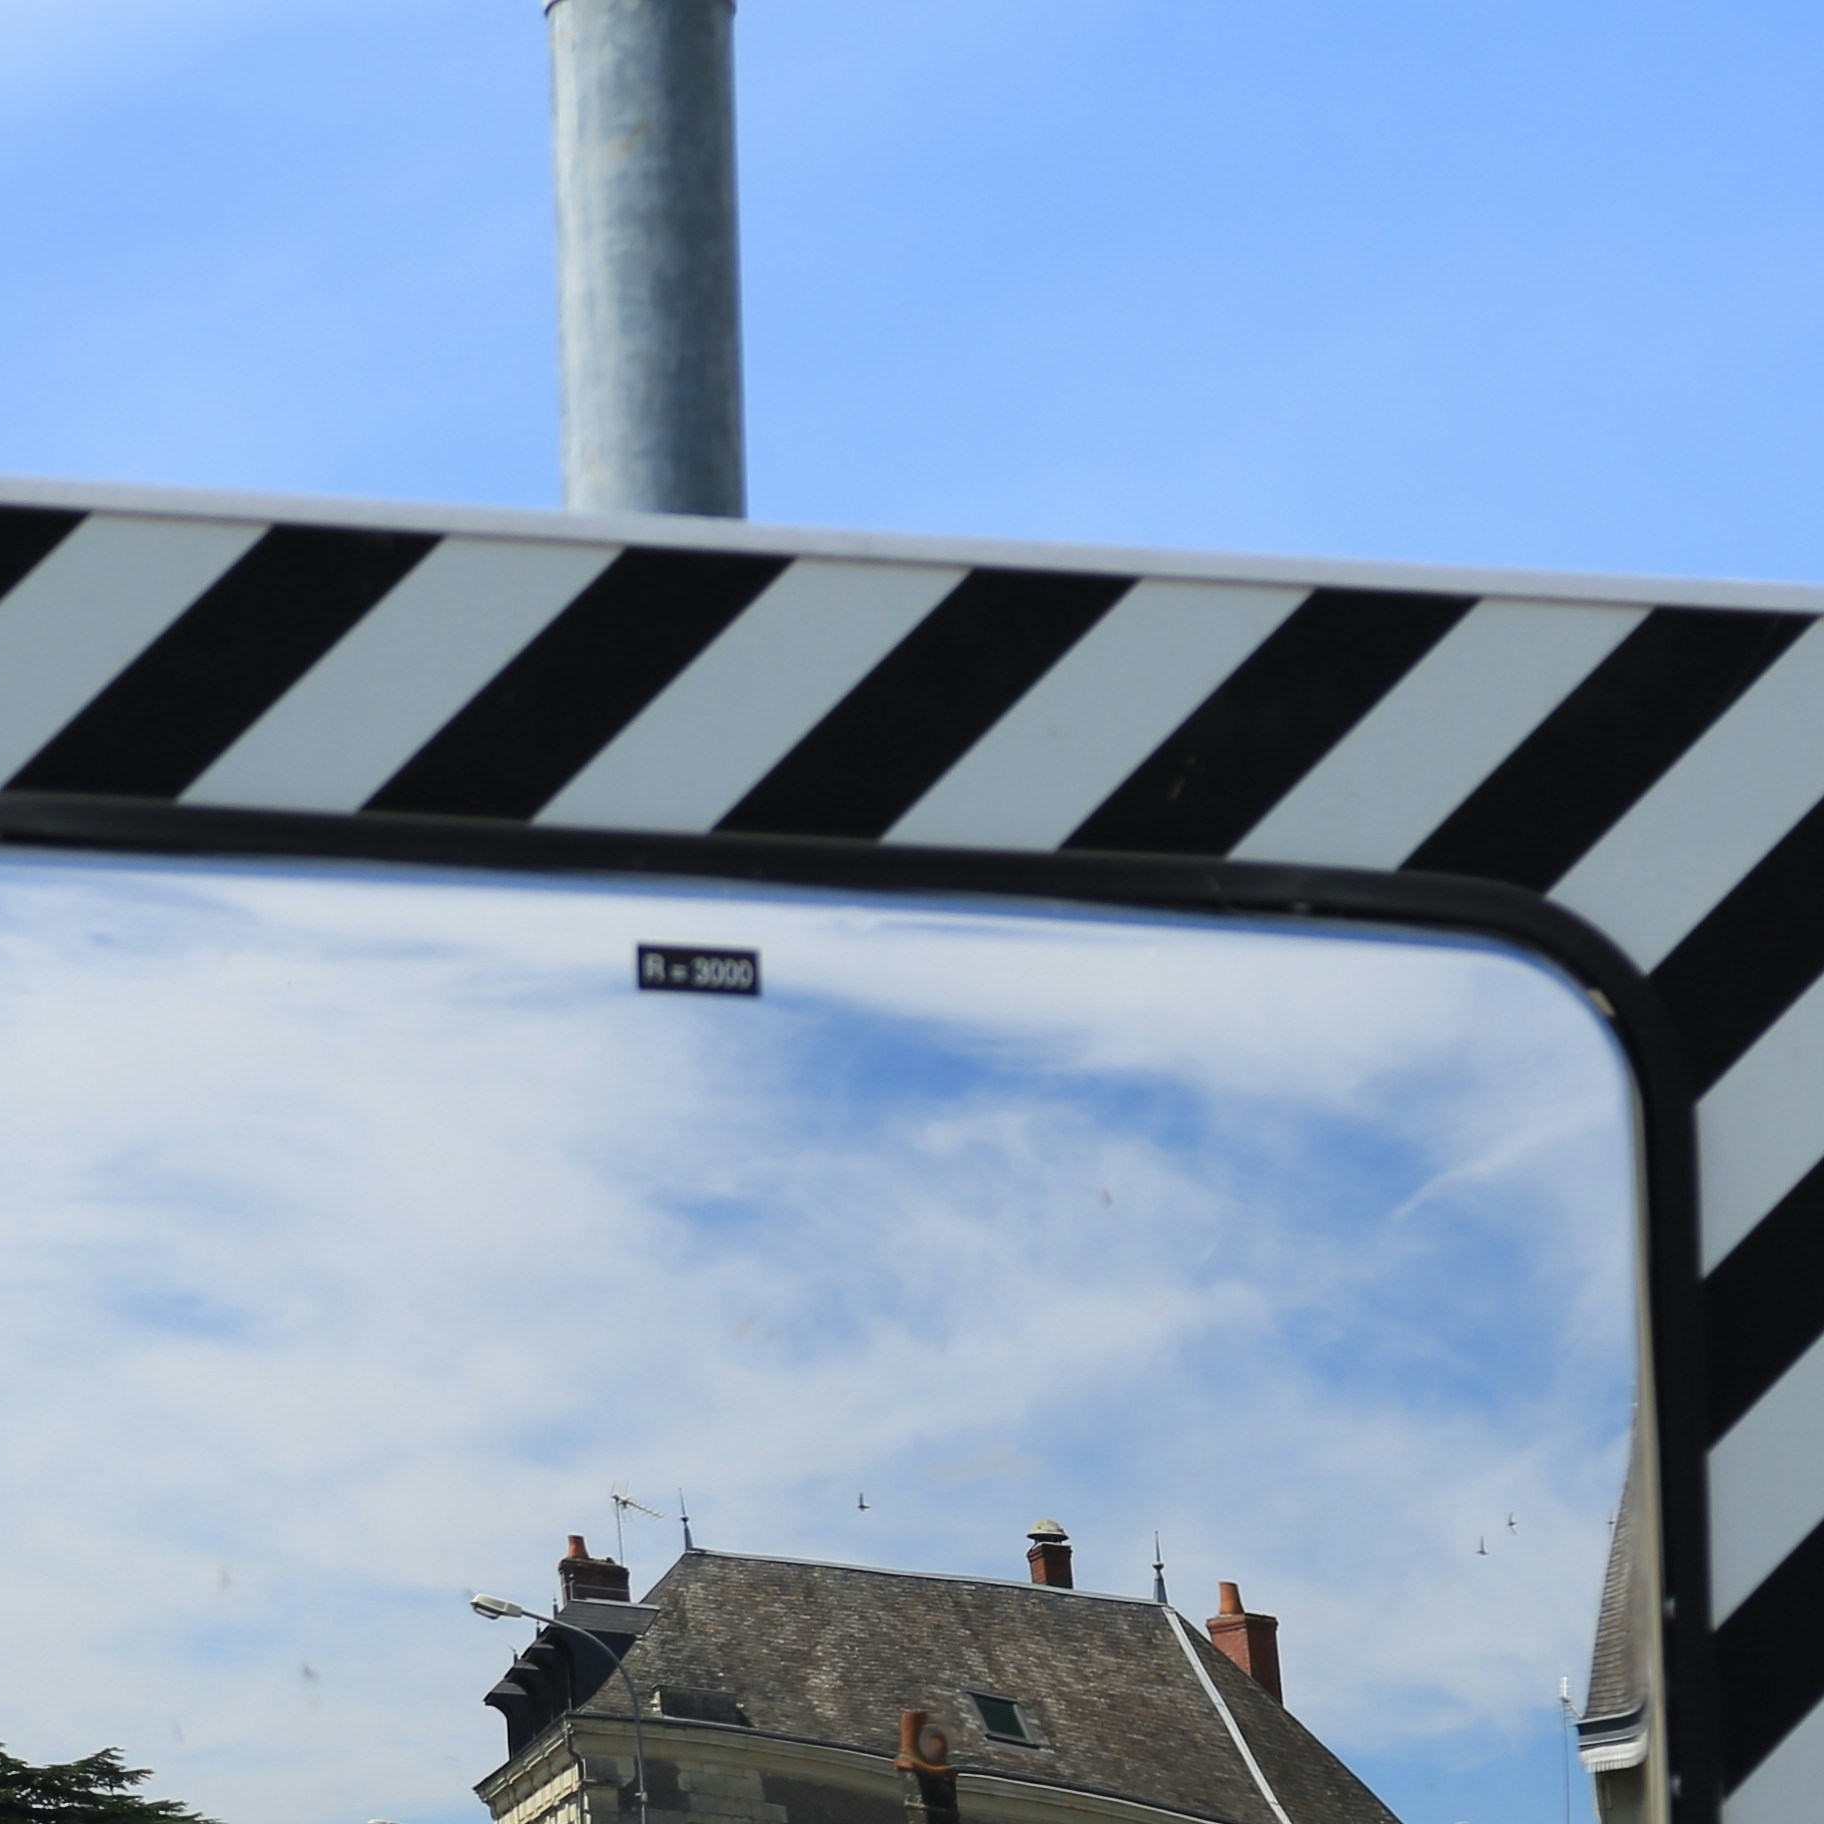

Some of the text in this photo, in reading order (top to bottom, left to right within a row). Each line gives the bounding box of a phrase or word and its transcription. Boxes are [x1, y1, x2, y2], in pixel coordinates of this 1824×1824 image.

[643, 953, 754, 989] R = 3000
